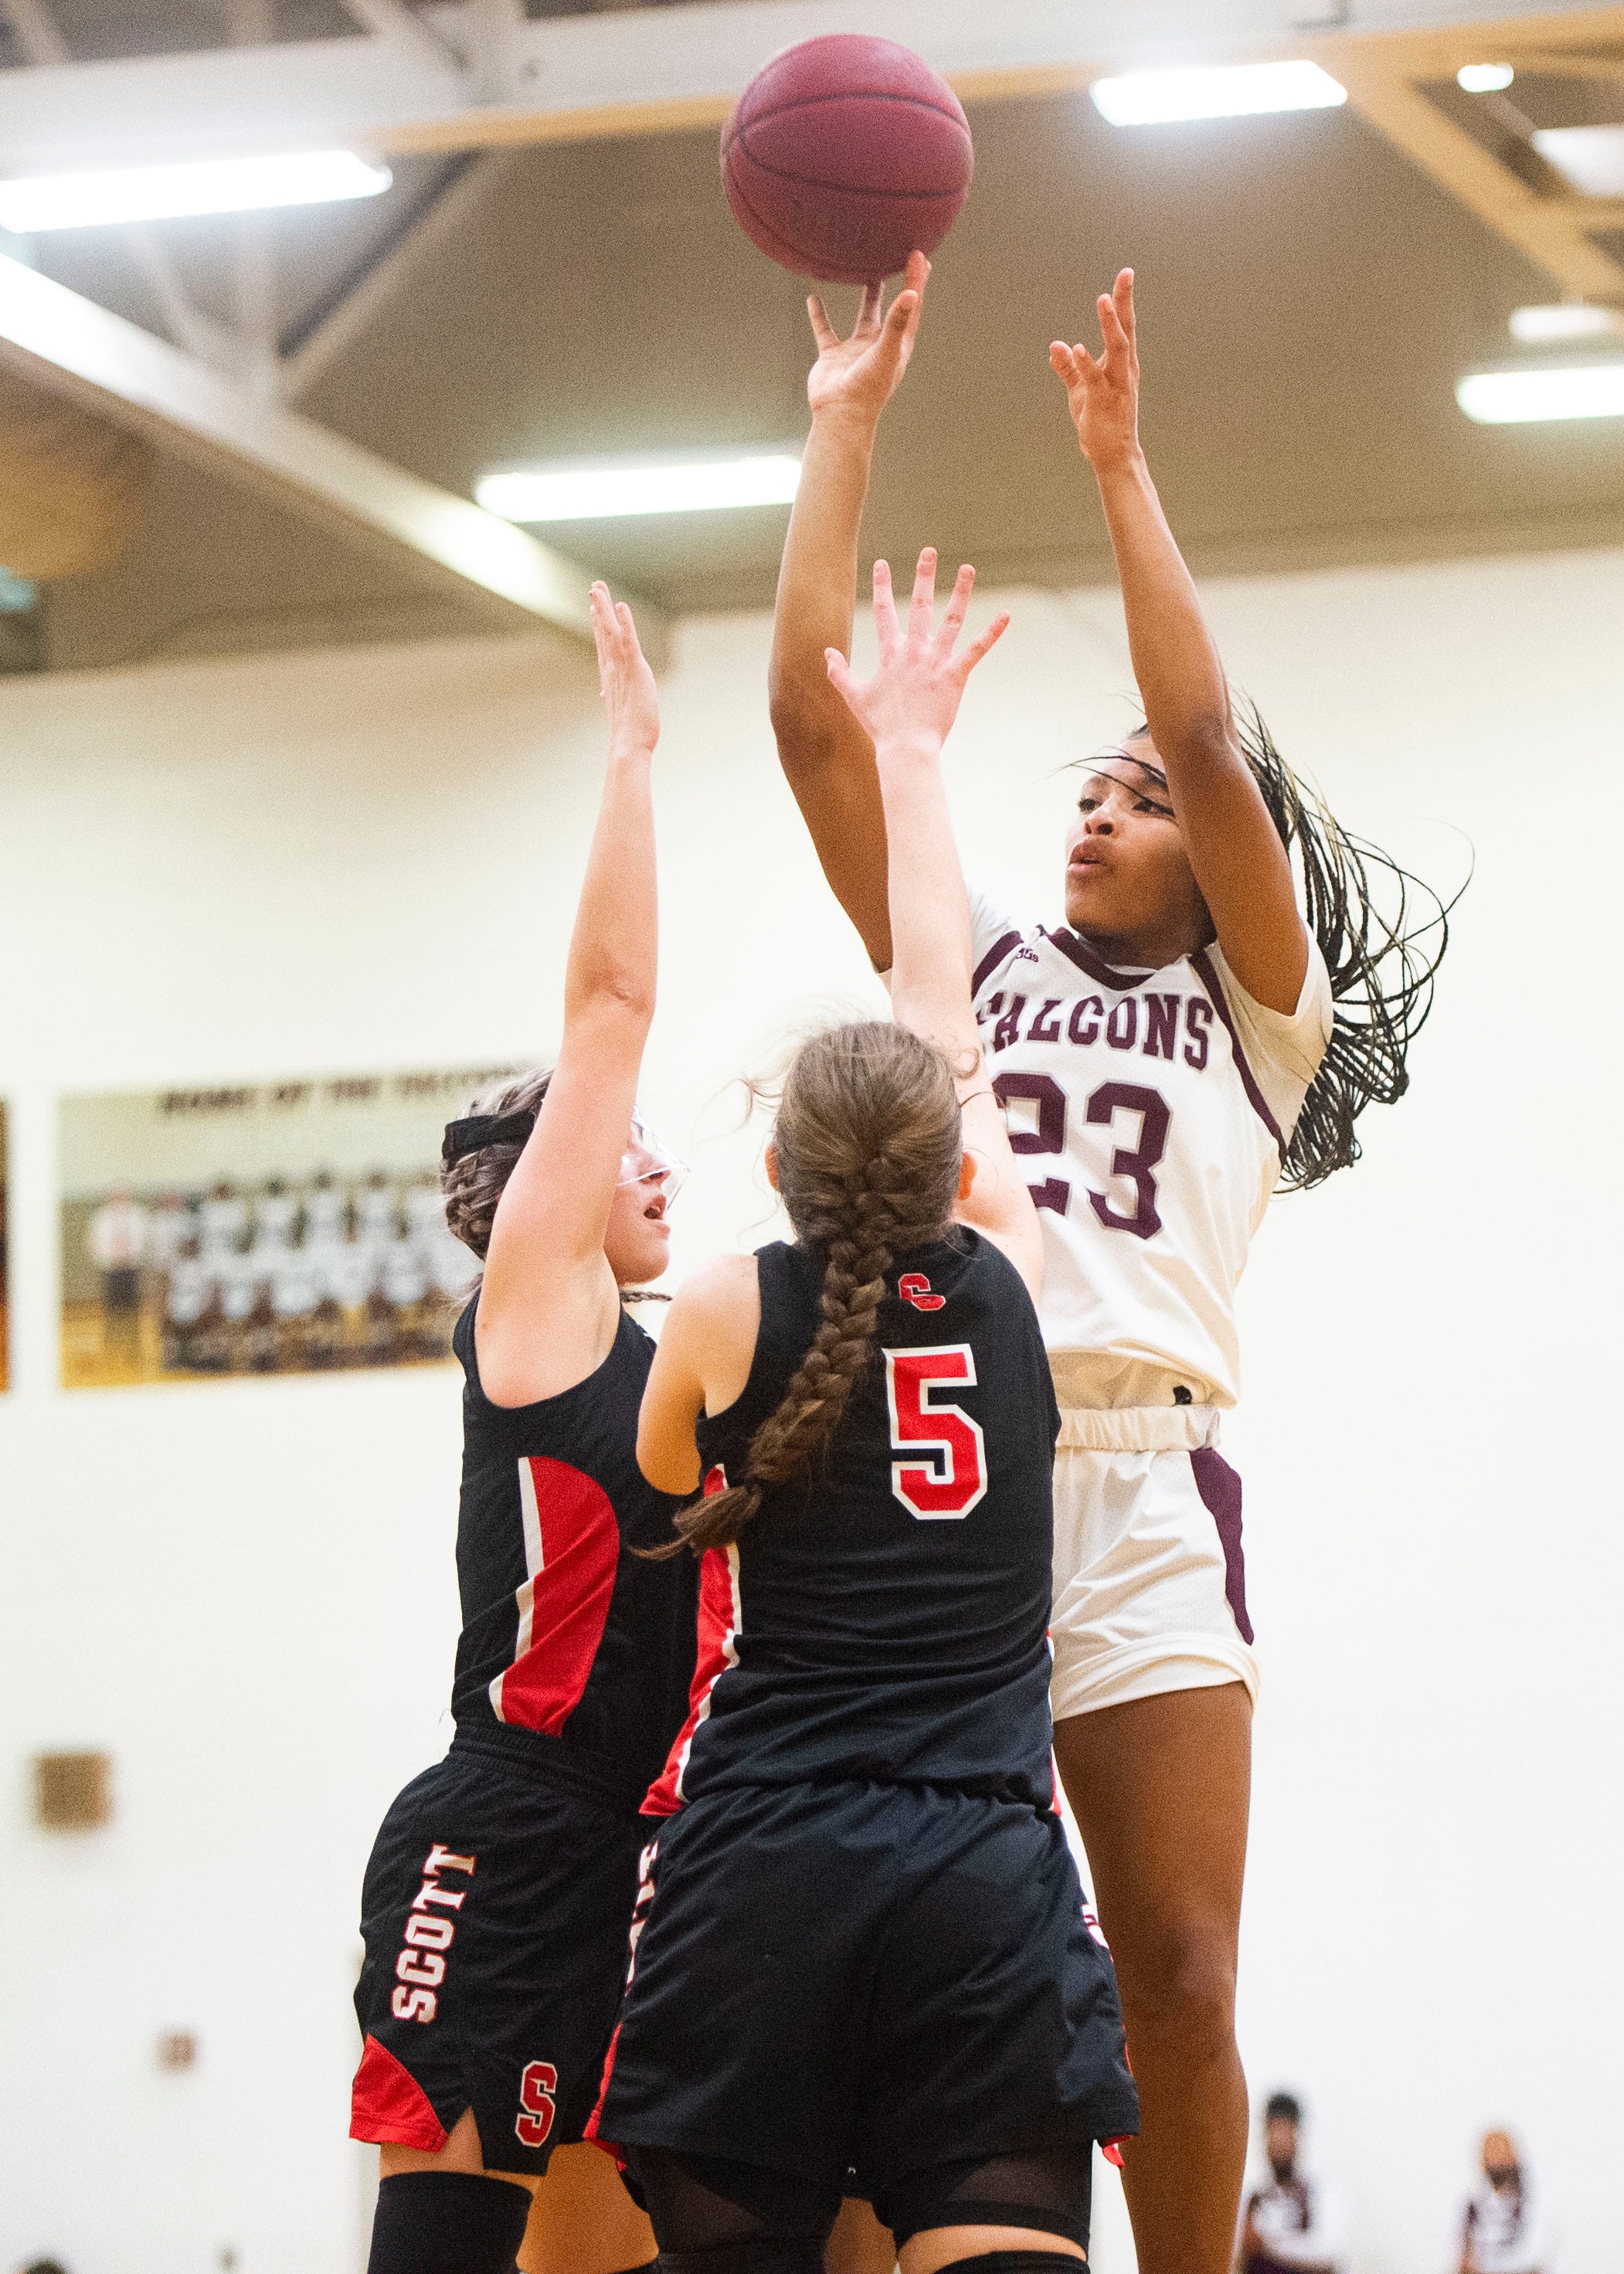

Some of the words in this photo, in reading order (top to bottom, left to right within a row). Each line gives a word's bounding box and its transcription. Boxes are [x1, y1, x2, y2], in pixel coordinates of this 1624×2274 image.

[992, 1070, 1173, 1240] 23
[882, 1344, 987, 1520] 5
[391, 1844, 476, 2024] SCOTT
[515, 2060, 558, 2147] S
